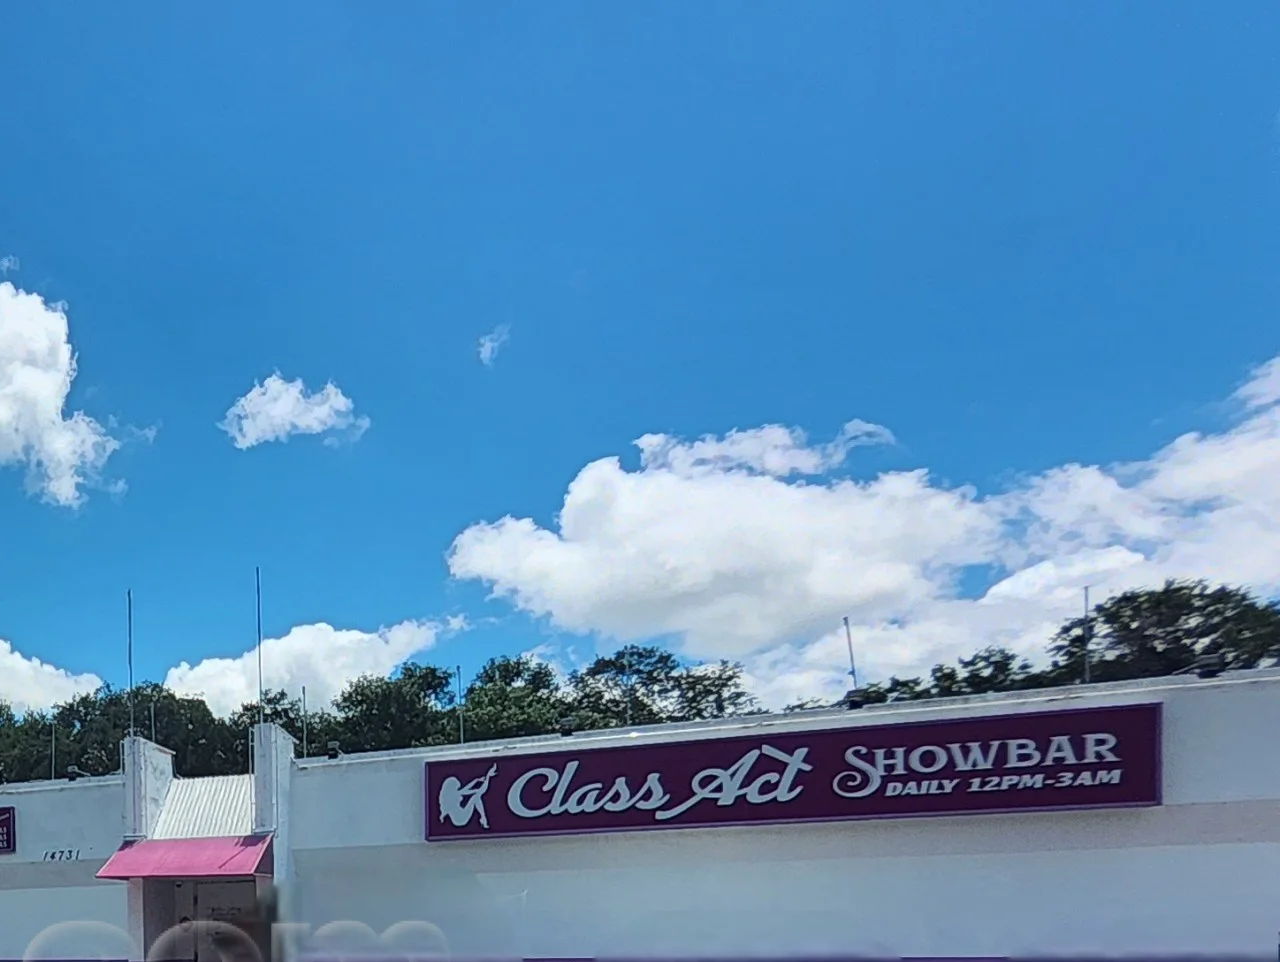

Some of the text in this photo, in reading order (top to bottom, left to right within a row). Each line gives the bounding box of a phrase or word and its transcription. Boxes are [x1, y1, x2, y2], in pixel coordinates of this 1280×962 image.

[507, 744, 813, 820] Class Act
[832, 733, 1123, 798] SHOWBAR
[884, 768, 1124, 797] DAILY 12PM-3AM
[43, 849, 80, 861] 14731
